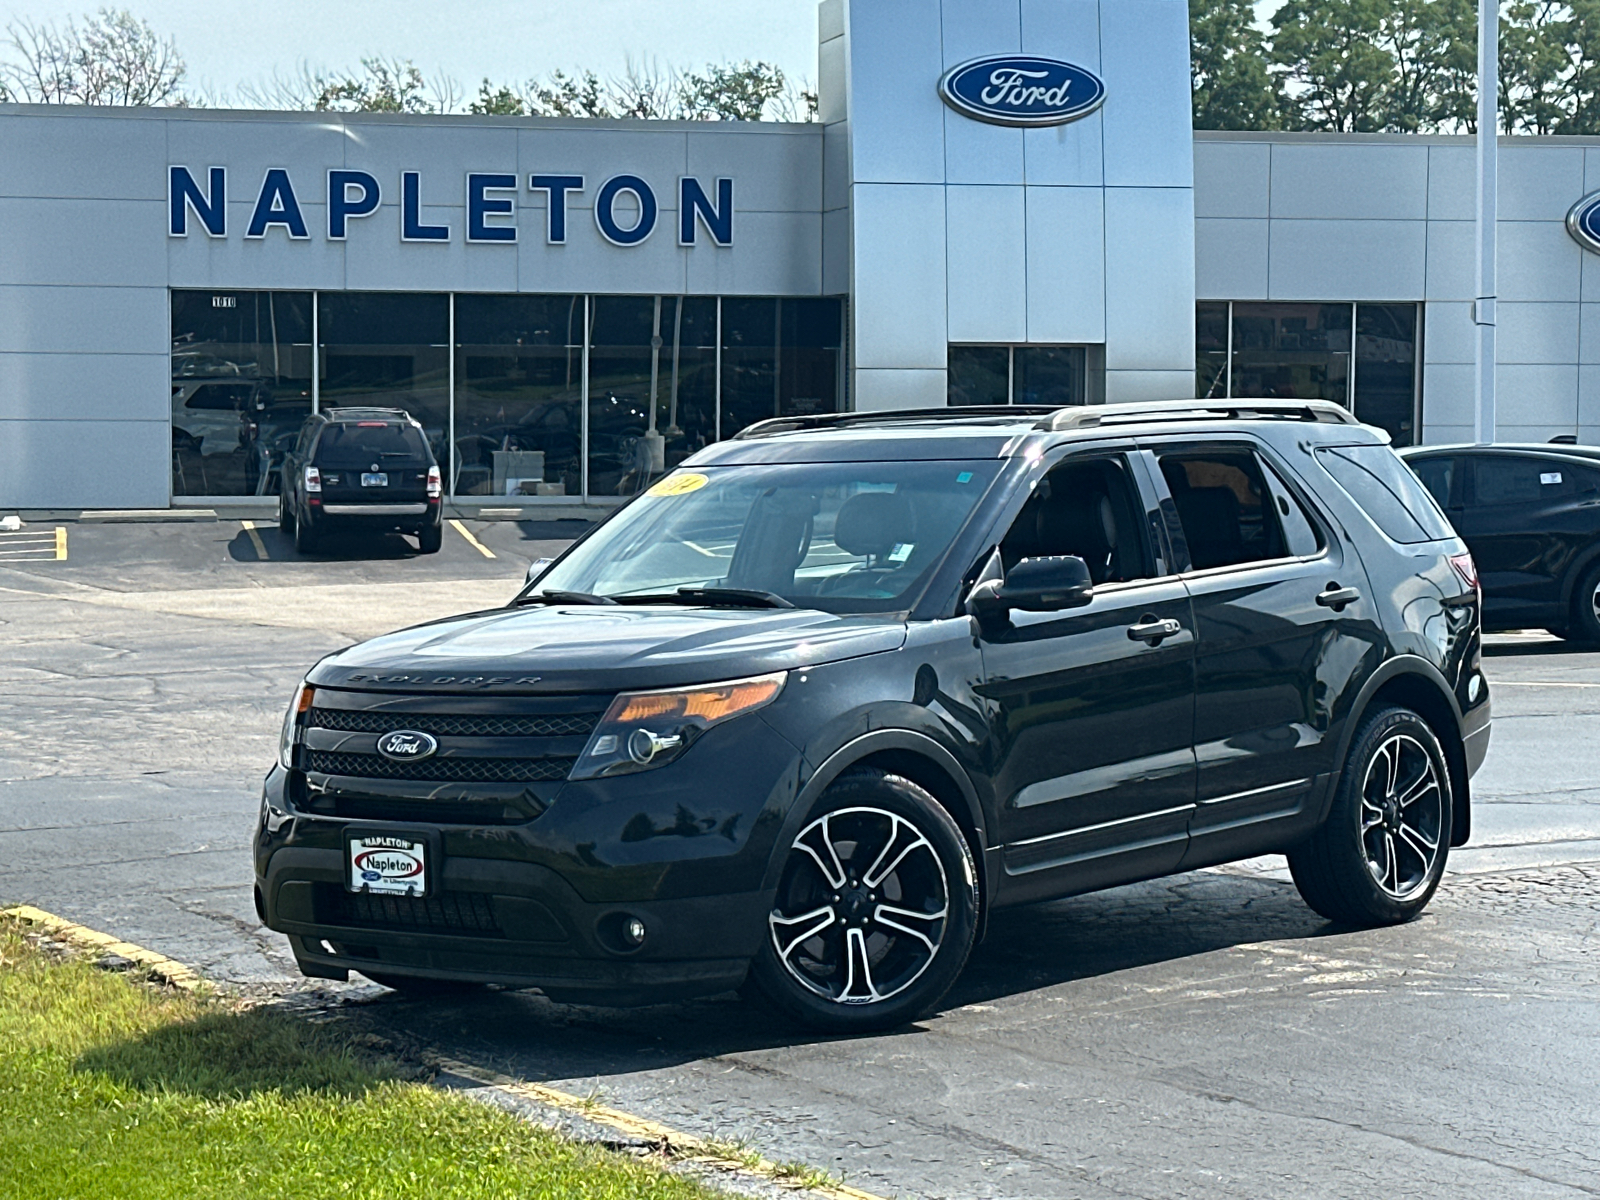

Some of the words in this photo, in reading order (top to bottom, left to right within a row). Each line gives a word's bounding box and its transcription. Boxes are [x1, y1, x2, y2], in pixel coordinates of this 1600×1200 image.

[981, 68, 1072, 107] Ford
[167, 165, 735, 247] NAPLETON
[214, 297, 235, 307] 1010
[347, 674, 542, 685] EXPLORER
[386, 734, 421, 754] Ford
[365, 837, 408, 848] NAPLETON
[367, 856, 412, 872] Napleton
